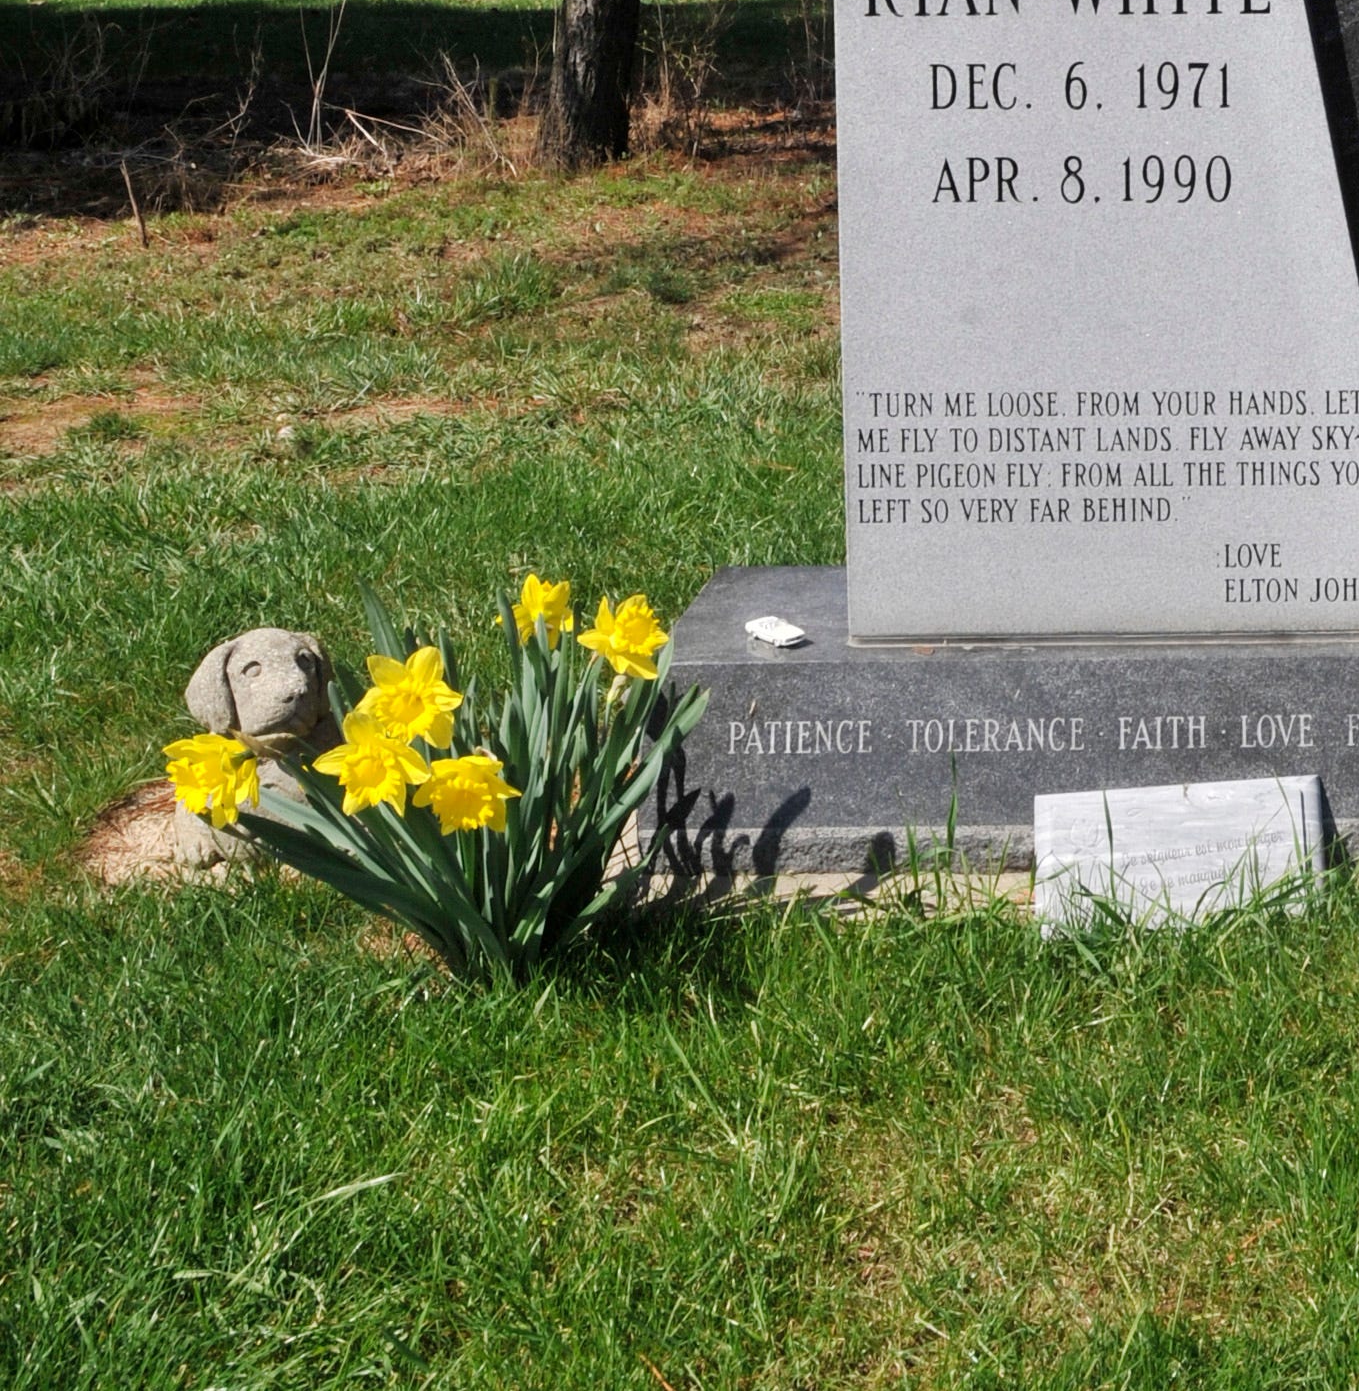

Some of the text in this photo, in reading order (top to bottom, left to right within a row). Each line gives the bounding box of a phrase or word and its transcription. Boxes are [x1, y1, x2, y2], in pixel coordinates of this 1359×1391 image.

[930, 62, 1033, 111] DEC.
[1136, 61, 1231, 110] 1971
[932, 156, 1040, 204] APR.
[1121, 154, 1232, 204] 1990
[944, 391, 978, 417] ME
[1077, 391, 1140, 417] FROM
[1152, 391, 1217, 416] YOUR
[857, 428, 890, 453] ME
[900, 427, 938, 453] FLY
[950, 427, 979, 453] TO
[989, 427, 1086, 453] DISTANT
[1190, 426, 1228, 452] FLY
[1239, 425, 1302, 451] AWAY
[857, 463, 907, 489] LINE
[916, 462, 996, 488] PIGEON
[1061, 462, 1122, 488] FROM
[1133, 462, 1174, 487] ALL
[1183, 462, 1227, 487] THE
[1236, 461, 1321, 487] THINGS
[858, 498, 911, 524] LEFT
[921, 498, 950, 524] SO
[960, 498, 1018, 524] VERY
[1029, 498, 1072, 524] FAR
[1225, 578, 1299, 603] ELTON
[727, 720, 873, 755] PATIENCE
[906, 716, 1085, 754] TOLERANCE
[1117, 715, 1207, 751] FAITH
[1240, 713, 1314, 749] LOVE
